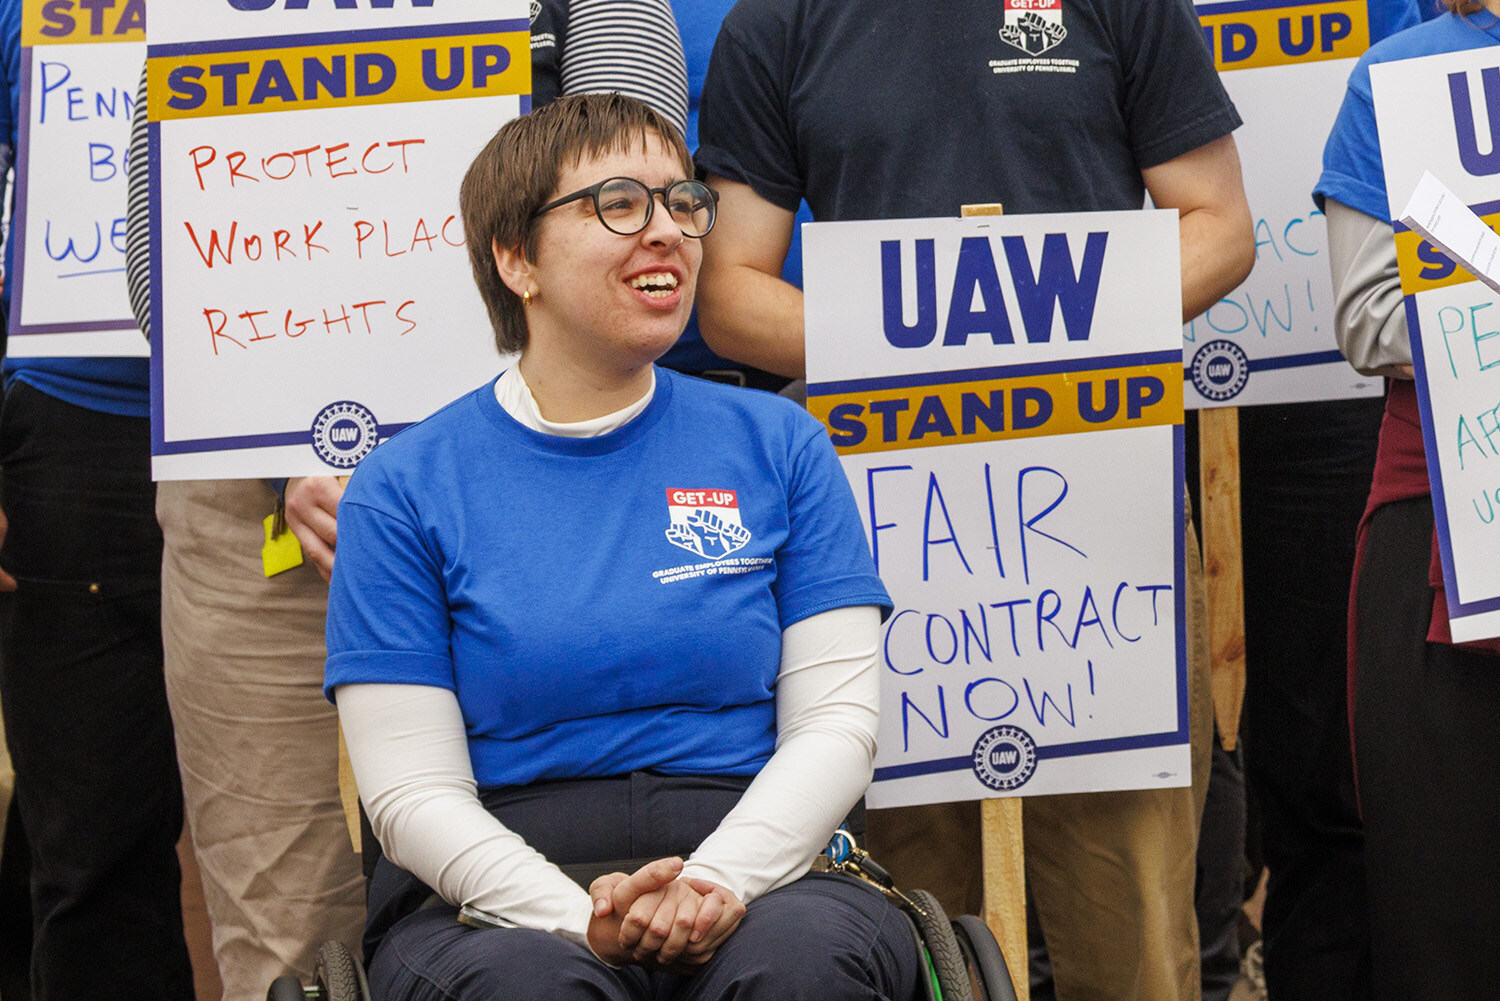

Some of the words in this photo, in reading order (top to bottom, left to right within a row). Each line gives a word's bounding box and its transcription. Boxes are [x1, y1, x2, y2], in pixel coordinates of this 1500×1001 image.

[1278, 12, 1352, 57] UP
[167, 53, 396, 111] STAND
[421, 45, 511, 91] UP
[188, 138, 425, 190] PROTECT
[184, 220, 330, 268] WORK
[356, 214, 467, 262] PLAC
[880, 231, 1109, 349] UAW
[1183, 279, 1318, 343] OW!
[202, 300, 417, 355] RIGHTS
[1207, 362, 1233, 378] UAW
[331, 426, 358, 444] UAW
[828, 386, 1053, 447] STAND
[1077, 376, 1165, 423] UP
[672, 491, 734, 506] GET-UP
[866, 463, 1088, 585] FAIR
[652, 564, 694, 579] GRADUATE
[695, 557, 740, 571] EMPLOYEES
[660, 570, 705, 584] UNIVERSITY
[706, 567, 718, 575] OF
[884, 582, 1173, 675] CONTRACT
[902, 660, 1095, 752] NOW!
[991, 748, 1017, 766] UAW
